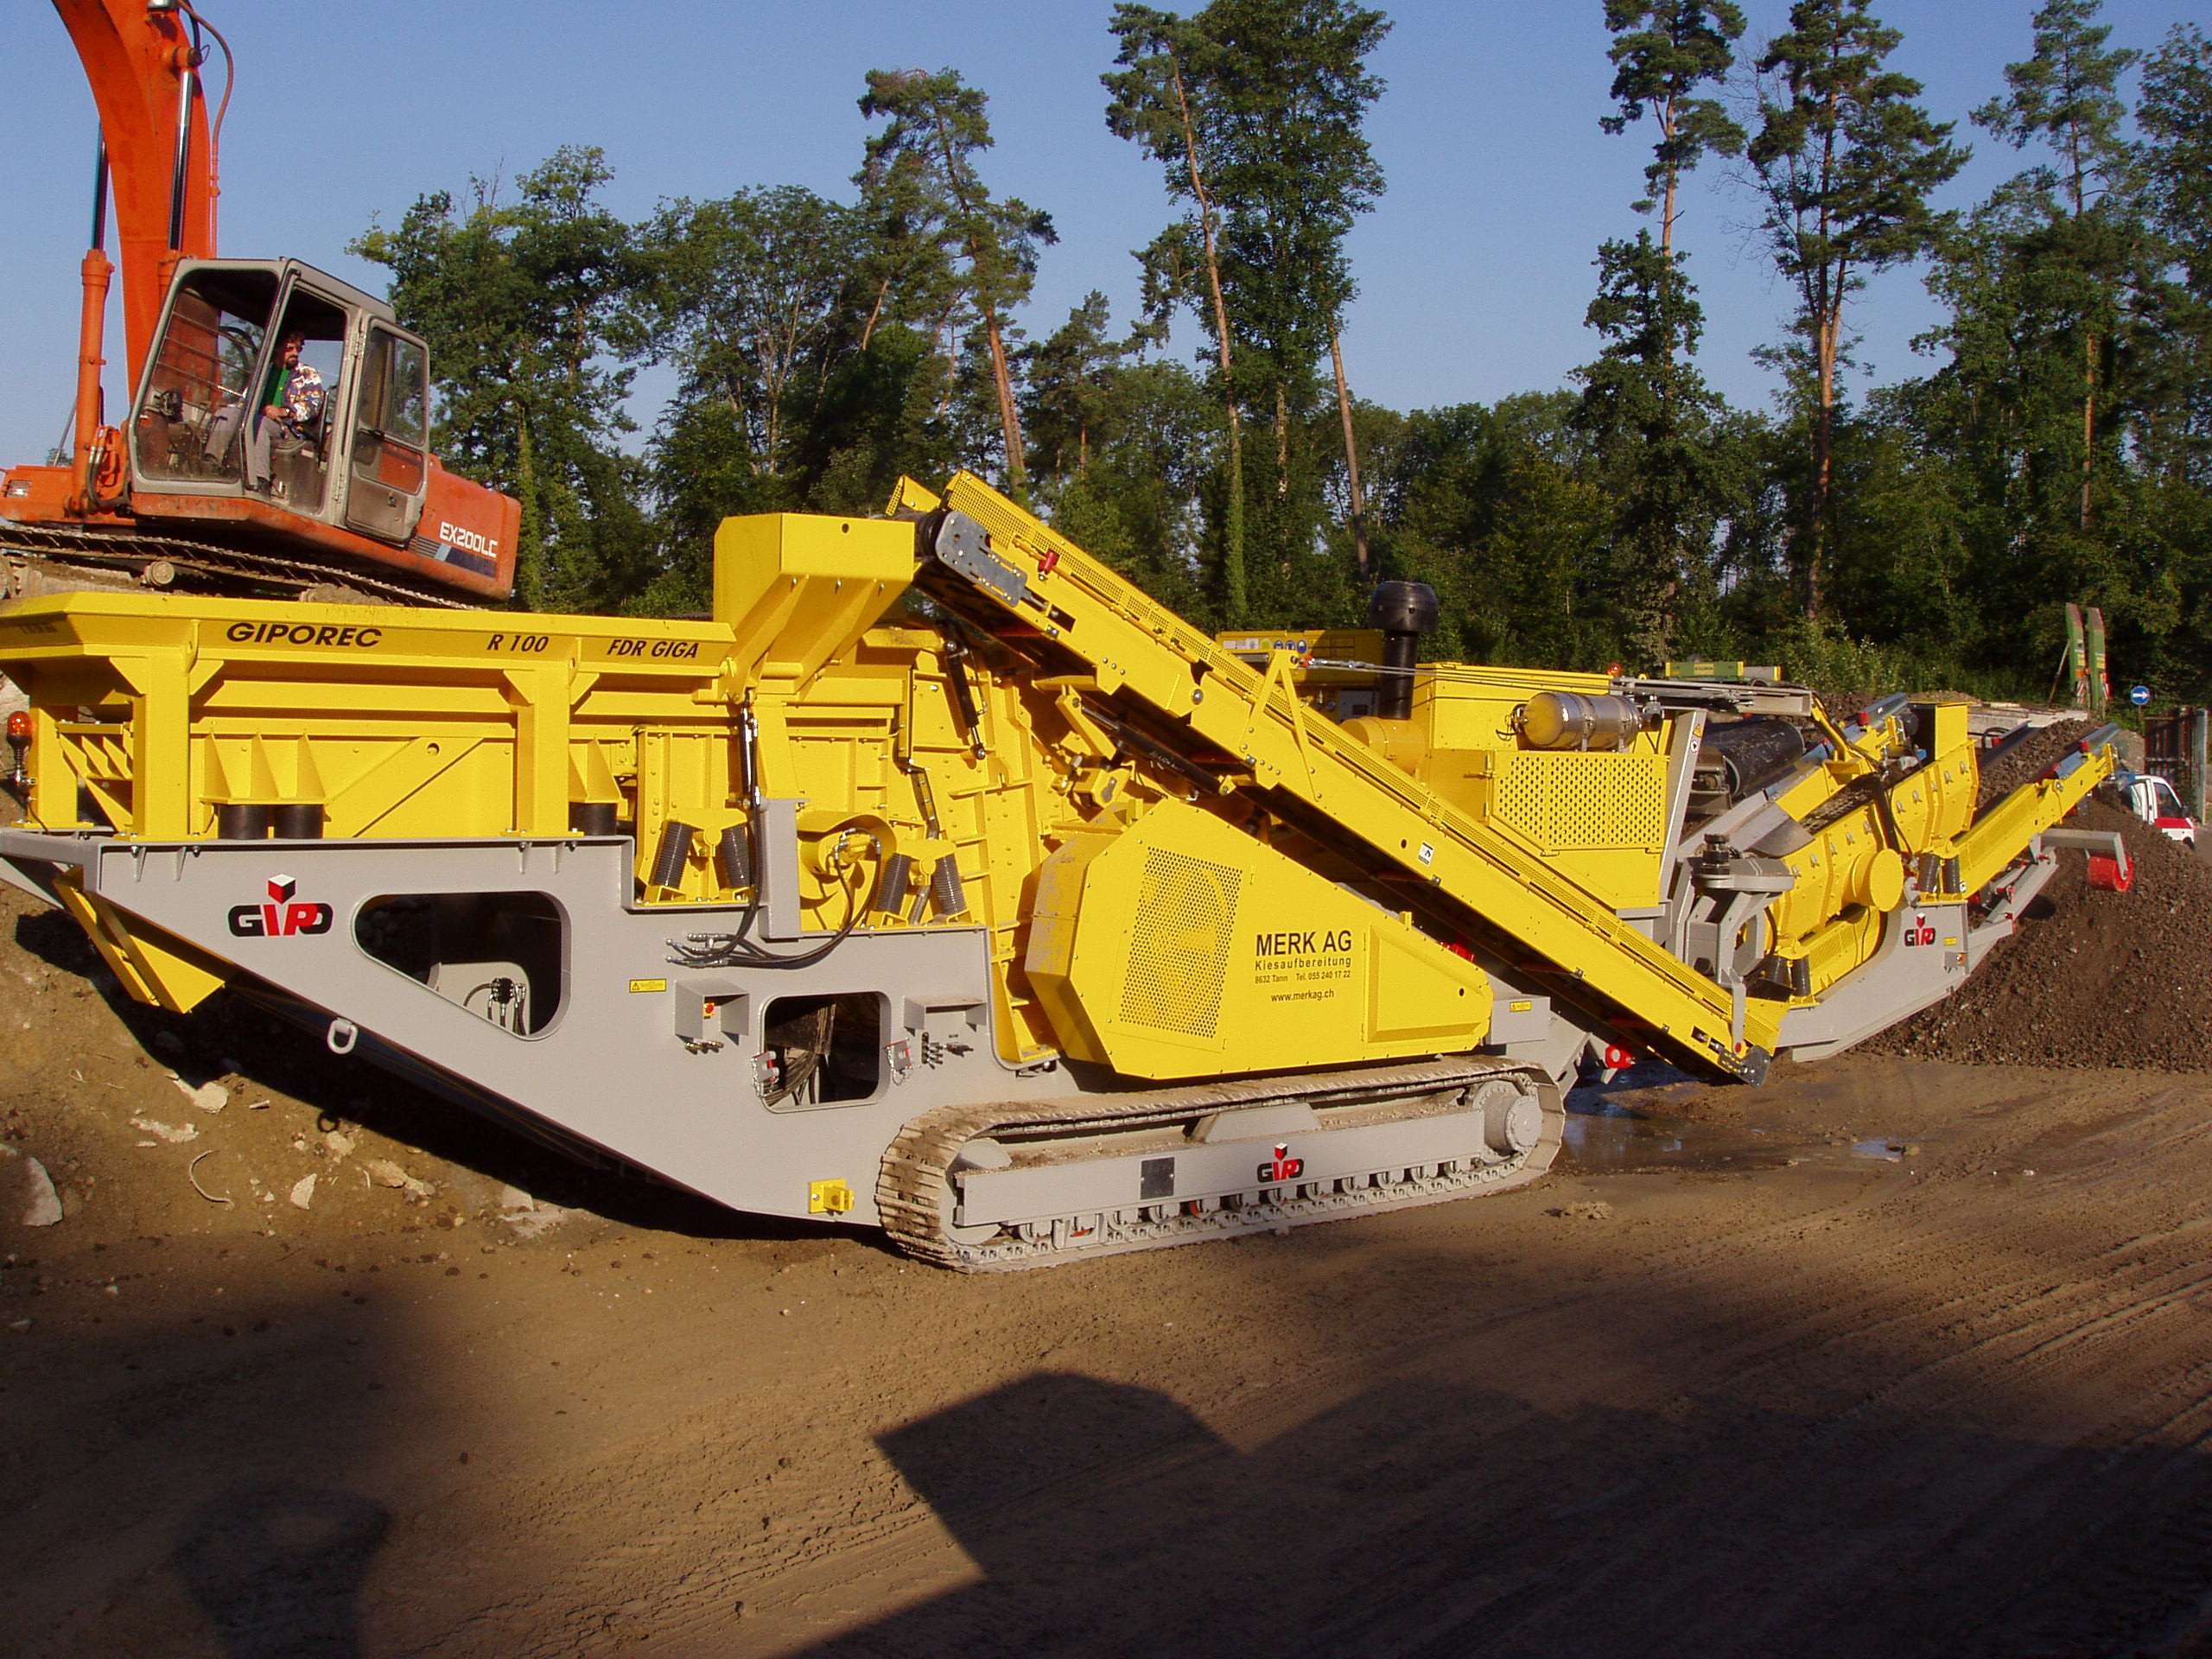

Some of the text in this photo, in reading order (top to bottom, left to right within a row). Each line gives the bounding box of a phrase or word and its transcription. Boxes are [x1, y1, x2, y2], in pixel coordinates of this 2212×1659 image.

[439, 521, 499, 558] EX200LC
[226, 622, 383, 647] GIPOREC
[487, 634, 550, 652] R 100
[607, 639, 699, 658] FDR GIGA
[1256, 930, 1352, 957] MERK AG
[1255, 957, 1351, 971] Kiesaufbereitung
[1255, 975, 1271, 984] 8632
[1272, 974, 1288, 982] Tann
[1308, 971, 1320, 981] 055
[1321, 970, 1332, 979] 240
[1335, 970, 1342, 979] 17
[1344, 969, 1351, 978] 22
[1271, 988, 1334, 1002] www.merkag.ch
